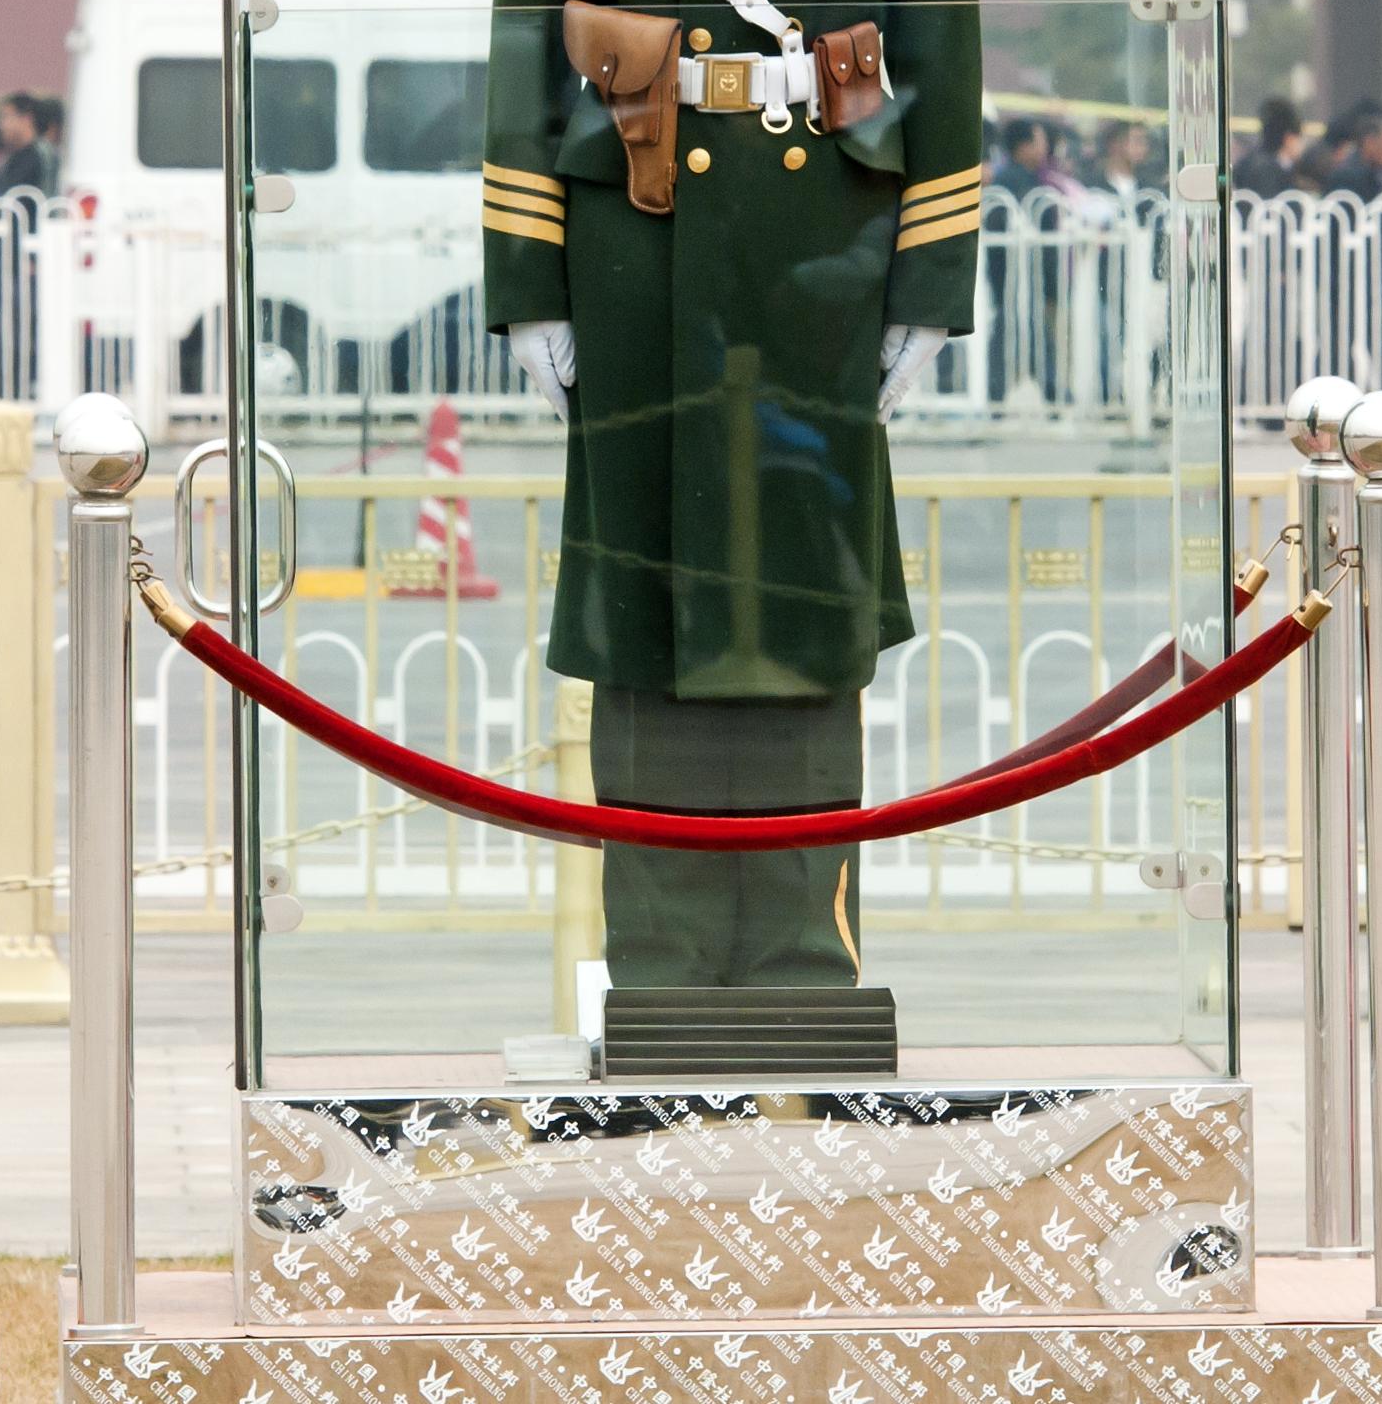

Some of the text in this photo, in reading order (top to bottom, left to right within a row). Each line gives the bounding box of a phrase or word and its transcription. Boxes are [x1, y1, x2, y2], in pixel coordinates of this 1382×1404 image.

[903, 1093, 931, 1123] CHINA
[726, 1112, 754, 1141] CHINA
[1196, 1121, 1224, 1151] CHINA
[547, 1132, 575, 1160] CHINA
[1018, 1139, 1046, 1168] CHINA
[428, 1148, 456, 1177] CHINA
[840, 1160, 867, 1189] CHINA
[249, 1169, 276, 1198] CHINA
[661, 1178, 690, 1207] CHINA
[1131, 1187, 1159, 1217] CHINA
[364, 1216, 392, 1245] CHINA
[953, 1206, 981, 1235] CHINA
[775, 1226, 802, 1255] CHINA
[597, 1245, 625, 1274] CHINA
[1067, 1254, 1095, 1283] CHINA
[477, 1262, 505, 1291] CHINA
[889, 1272, 917, 1301] CHINA
[299, 1282, 327, 1311] CHINA
[510, 1341, 538, 1370] CHINA
[1098, 1332, 1127, 1361] CHINA
[330, 1360, 359, 1389] CHINA
[920, 1350, 948, 1379] CHINA
[739, 1370, 768, 1399] CHINA
